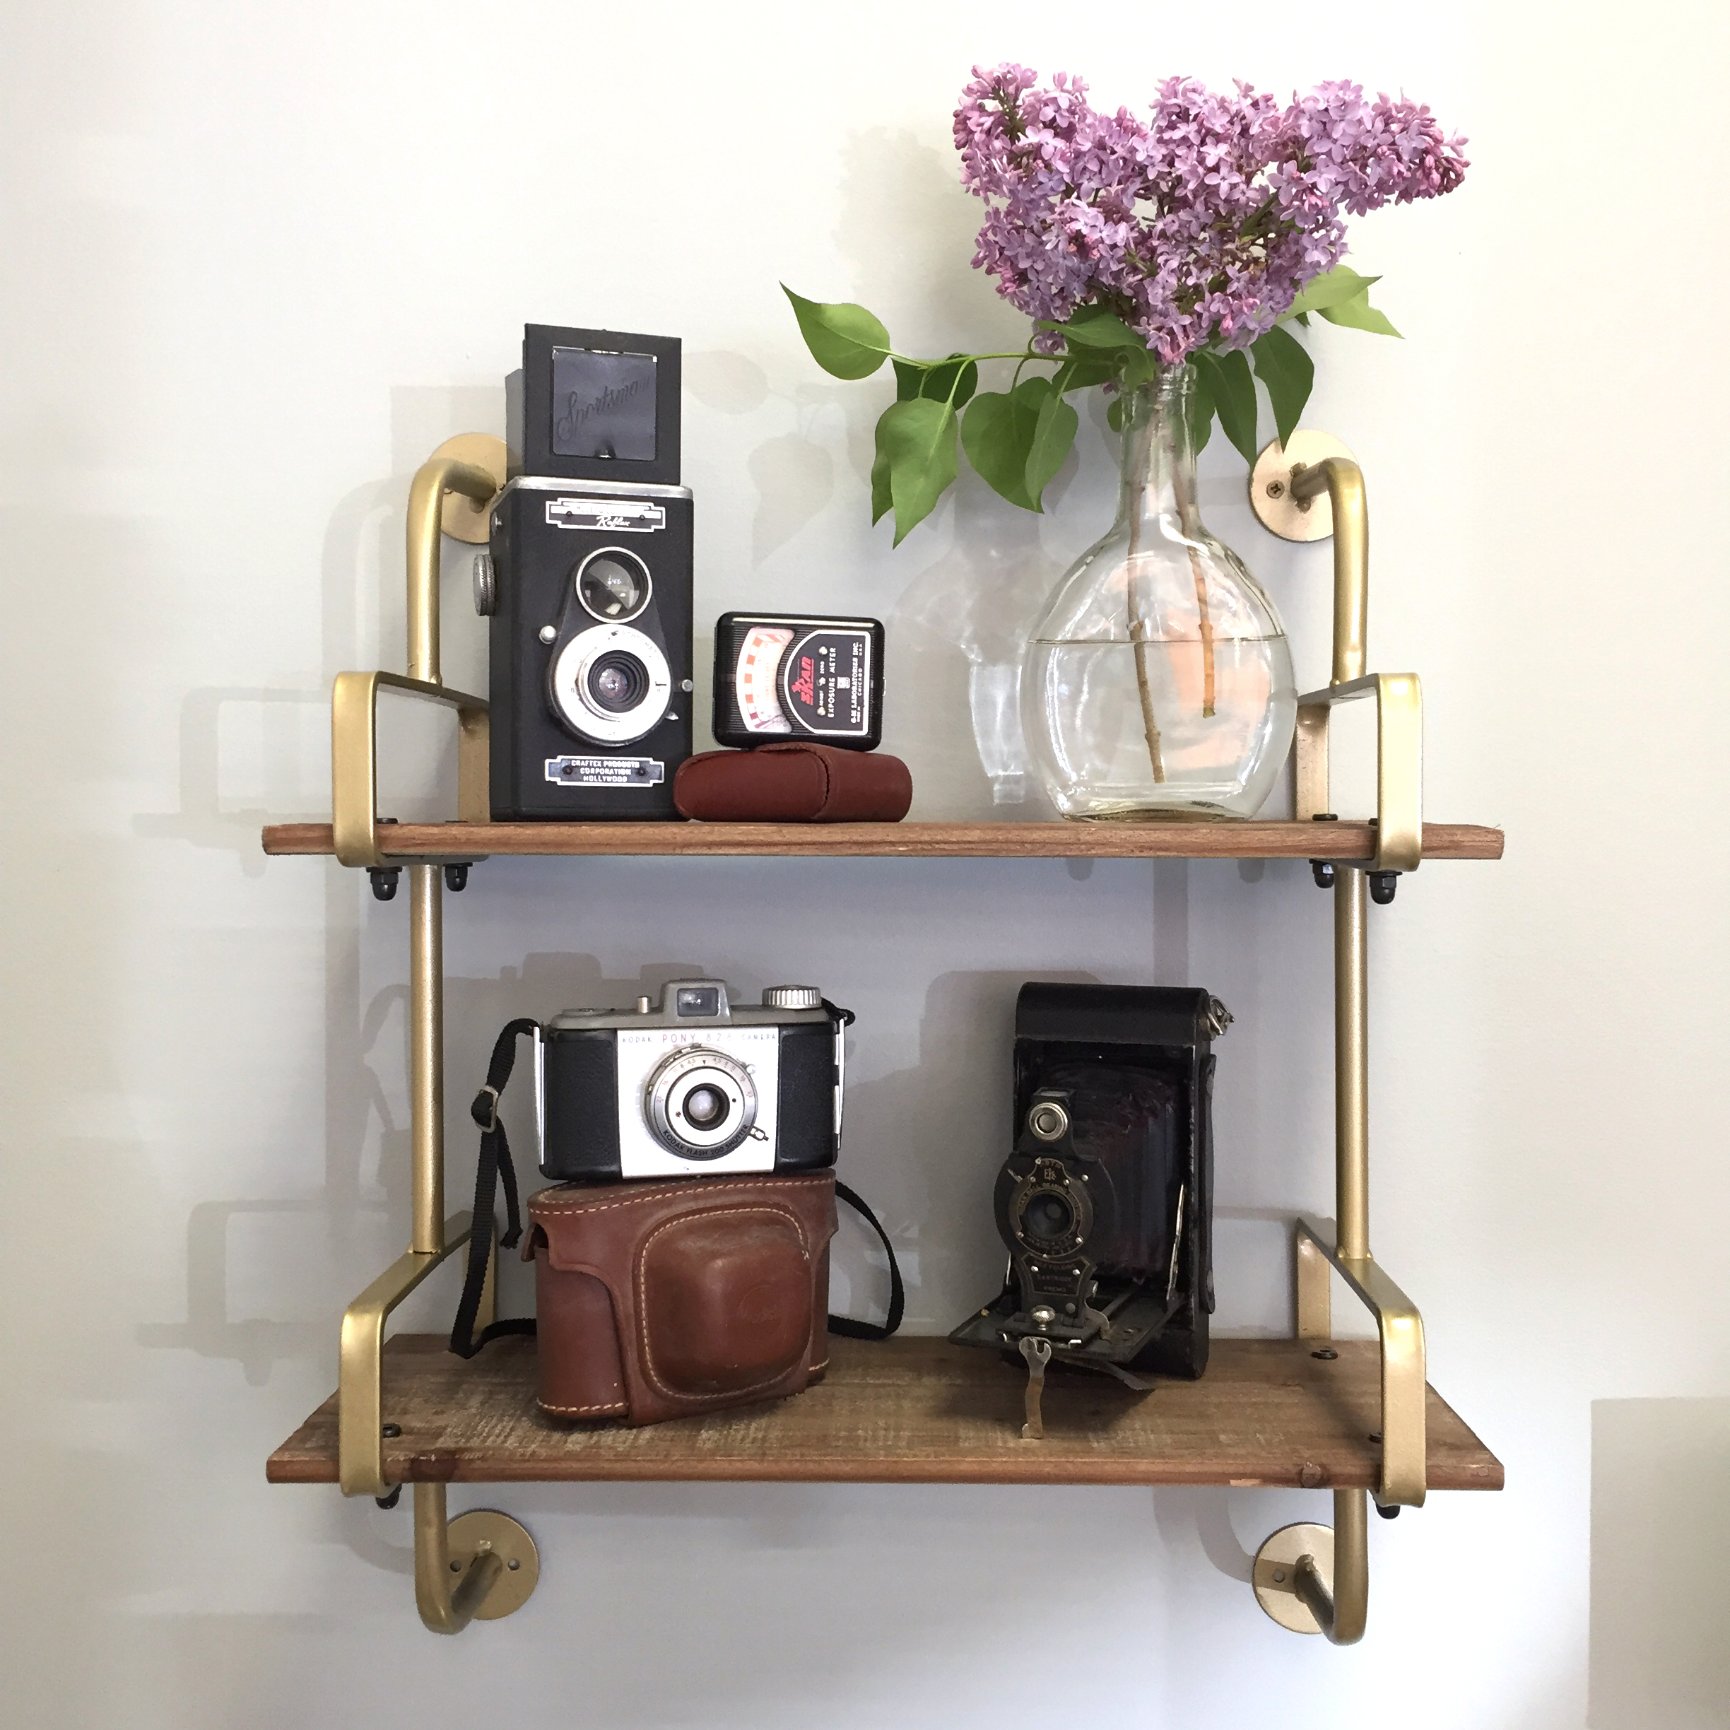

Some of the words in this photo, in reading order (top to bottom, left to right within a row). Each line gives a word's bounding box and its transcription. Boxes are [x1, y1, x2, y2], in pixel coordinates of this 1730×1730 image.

[829, 647, 837, 673] METER
[827, 677, 836, 718] EXPOSURE
[603, 760, 640, 768] PRODUCTS
[662, 1033, 696, 1044] PONY
[663, 1129, 685, 1152] KODAK
[686, 1147, 708, 1156] FLASH
[725, 1124, 749, 1149] SHUTTER
